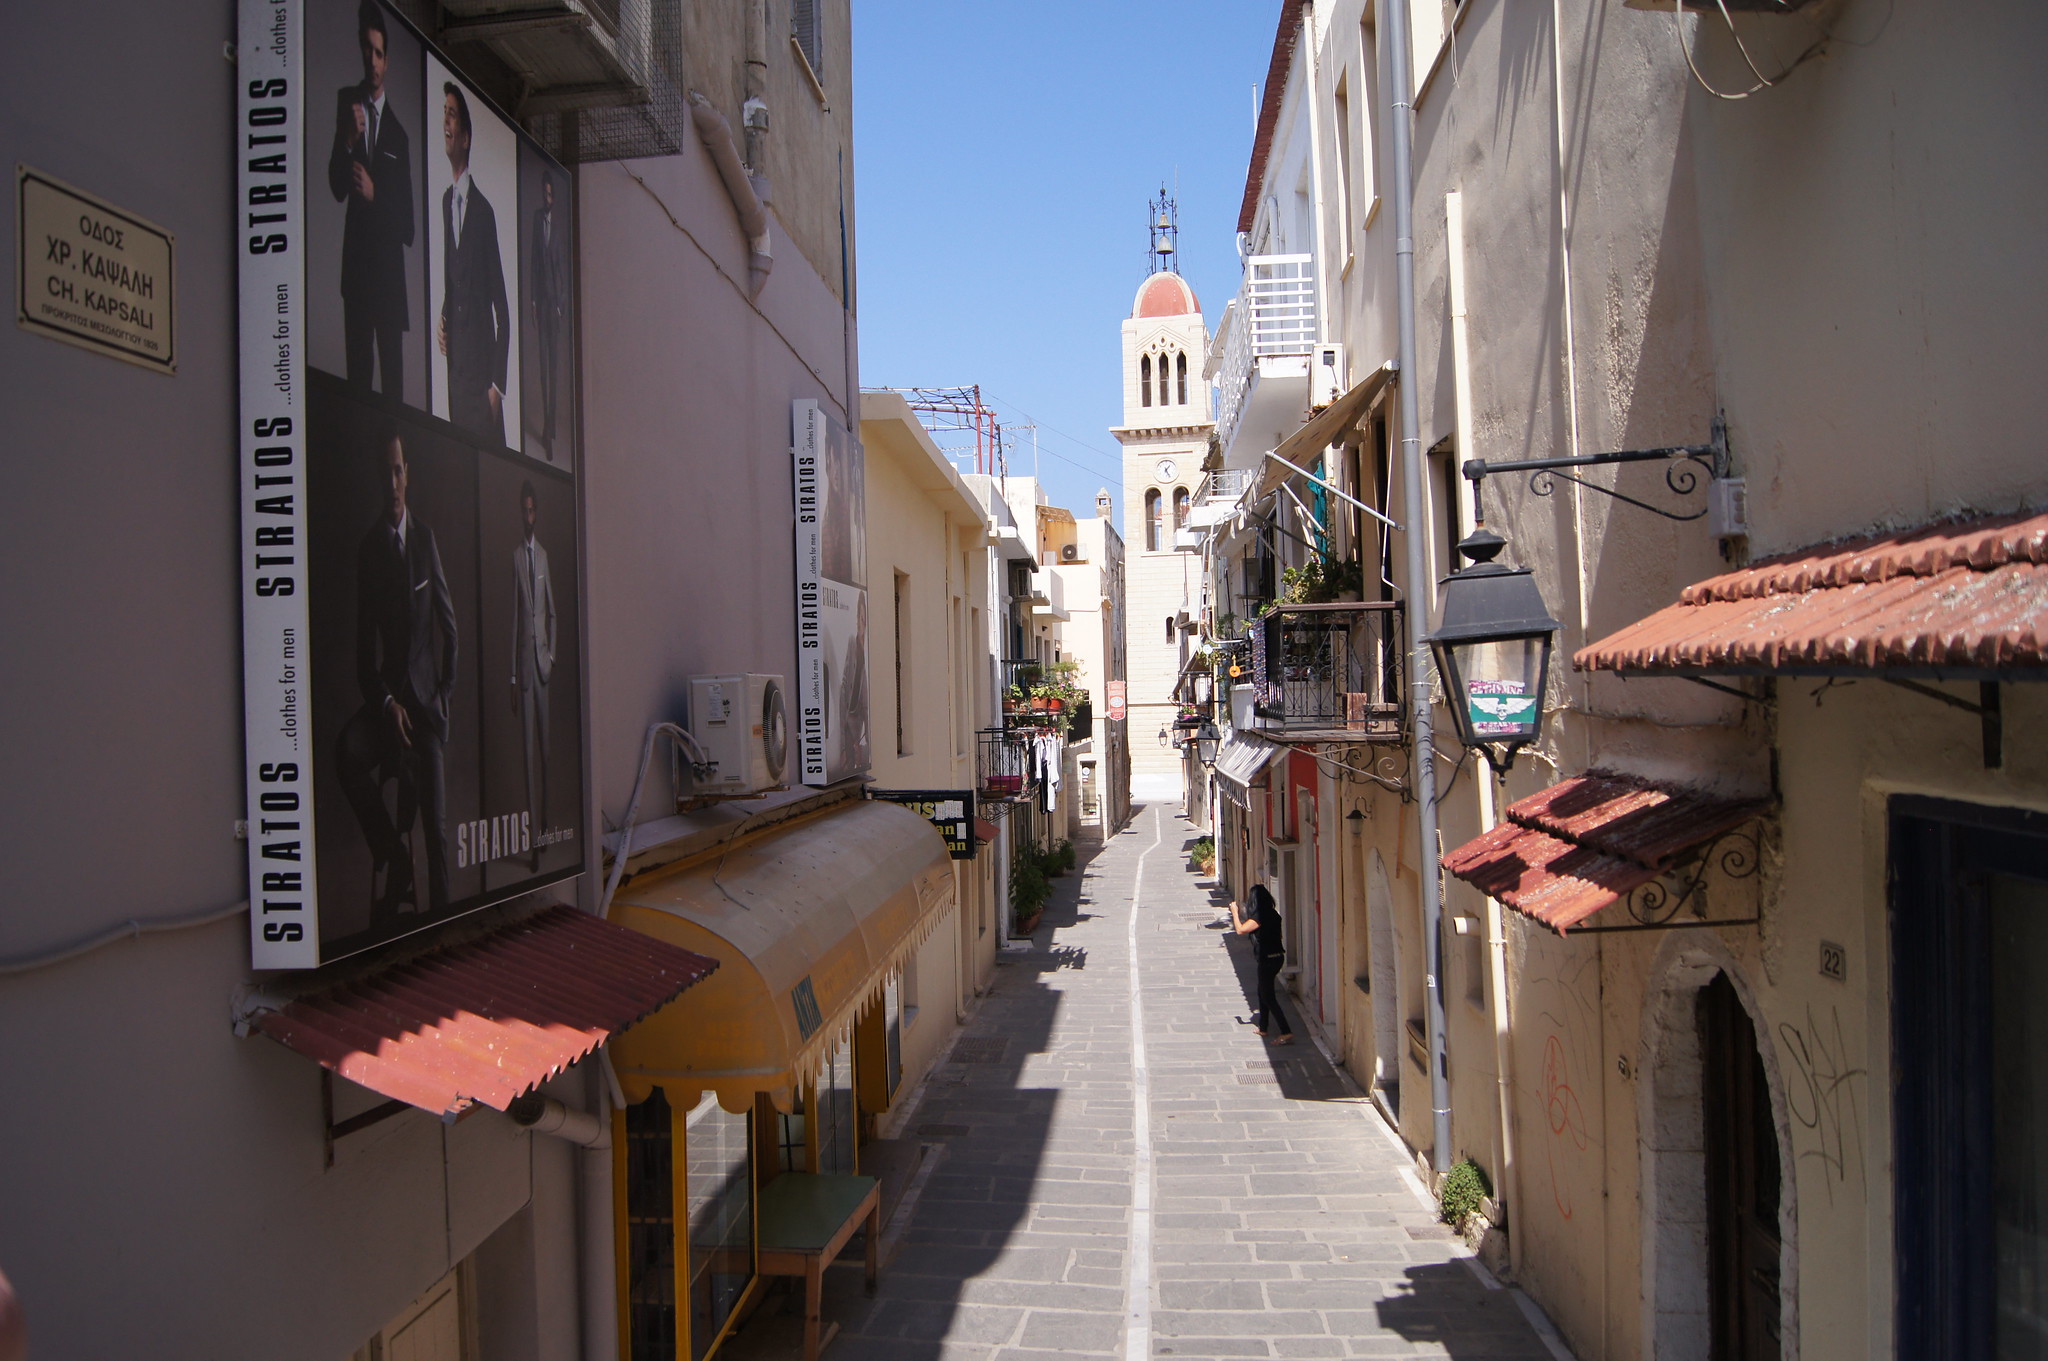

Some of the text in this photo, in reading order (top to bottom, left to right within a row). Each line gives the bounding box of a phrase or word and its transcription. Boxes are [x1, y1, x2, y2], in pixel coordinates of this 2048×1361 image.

[249, 77, 288, 255] STRATOS
[79, 215, 124, 250] ΟΔΟΣ
[82, 249, 153, 299] ΚΑΨΑΛΗ
[276, 283, 289, 314] men
[47, 276, 153, 330] CH. KAPSALI
[272, 319, 289, 340] for
[254, 415, 295, 597] STRATOS
[799, 457, 816, 523] STRATOS
[801, 582, 819, 648] STRATOS
[283, 628, 295, 659] men
[278, 664, 296, 683] for
[805, 707, 823, 774] STRATOS
[259, 762, 303, 943] STRATOS
[457, 810, 531, 869] STRATOS
[1824, 949, 1839, 974] 22
